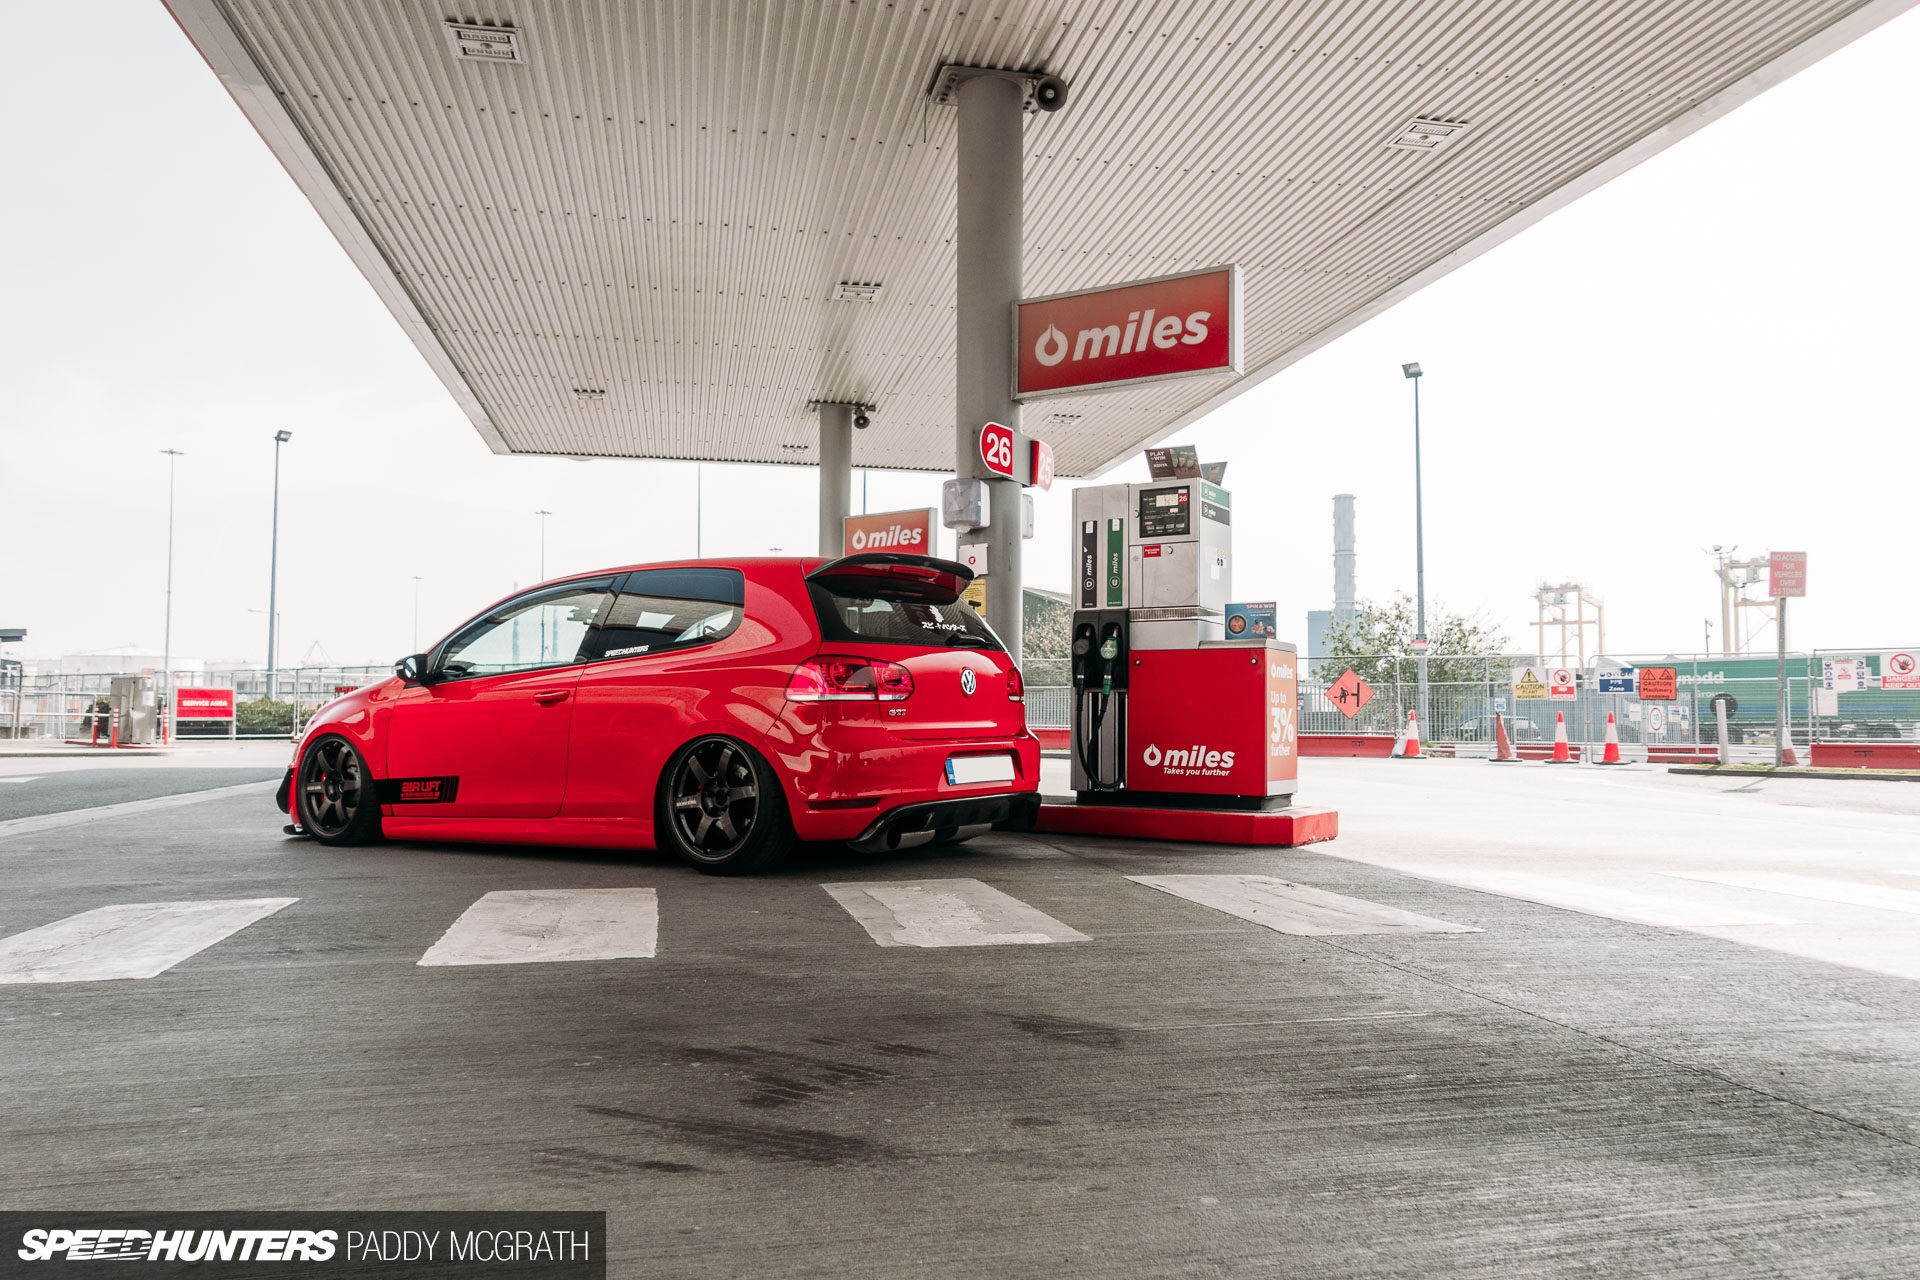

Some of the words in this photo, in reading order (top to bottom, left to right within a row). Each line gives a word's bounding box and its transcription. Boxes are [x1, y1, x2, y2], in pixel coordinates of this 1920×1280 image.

[1072, 308, 1211, 361] miles
[986, 432, 1011, 468] 26
[1039, 451, 1052, 483] 25
[867, 524, 923, 548] miles
[1085, 554, 1093, 576] miles
[1111, 552, 1119, 574] miles
[1276, 663, 1294, 679] miles
[1271, 690, 1280, 706] Up
[1280, 692, 1287, 704] to
[888, 708, 907, 717] GTI
[1271, 707, 1294, 743] 3%
[1163, 745, 1236, 769] miles
[1271, 743, 1291, 757] further
[1163, 767, 1185, 775] Takes
[1201, 768, 1231, 777] further
[420, 780, 442, 792] LIFT
